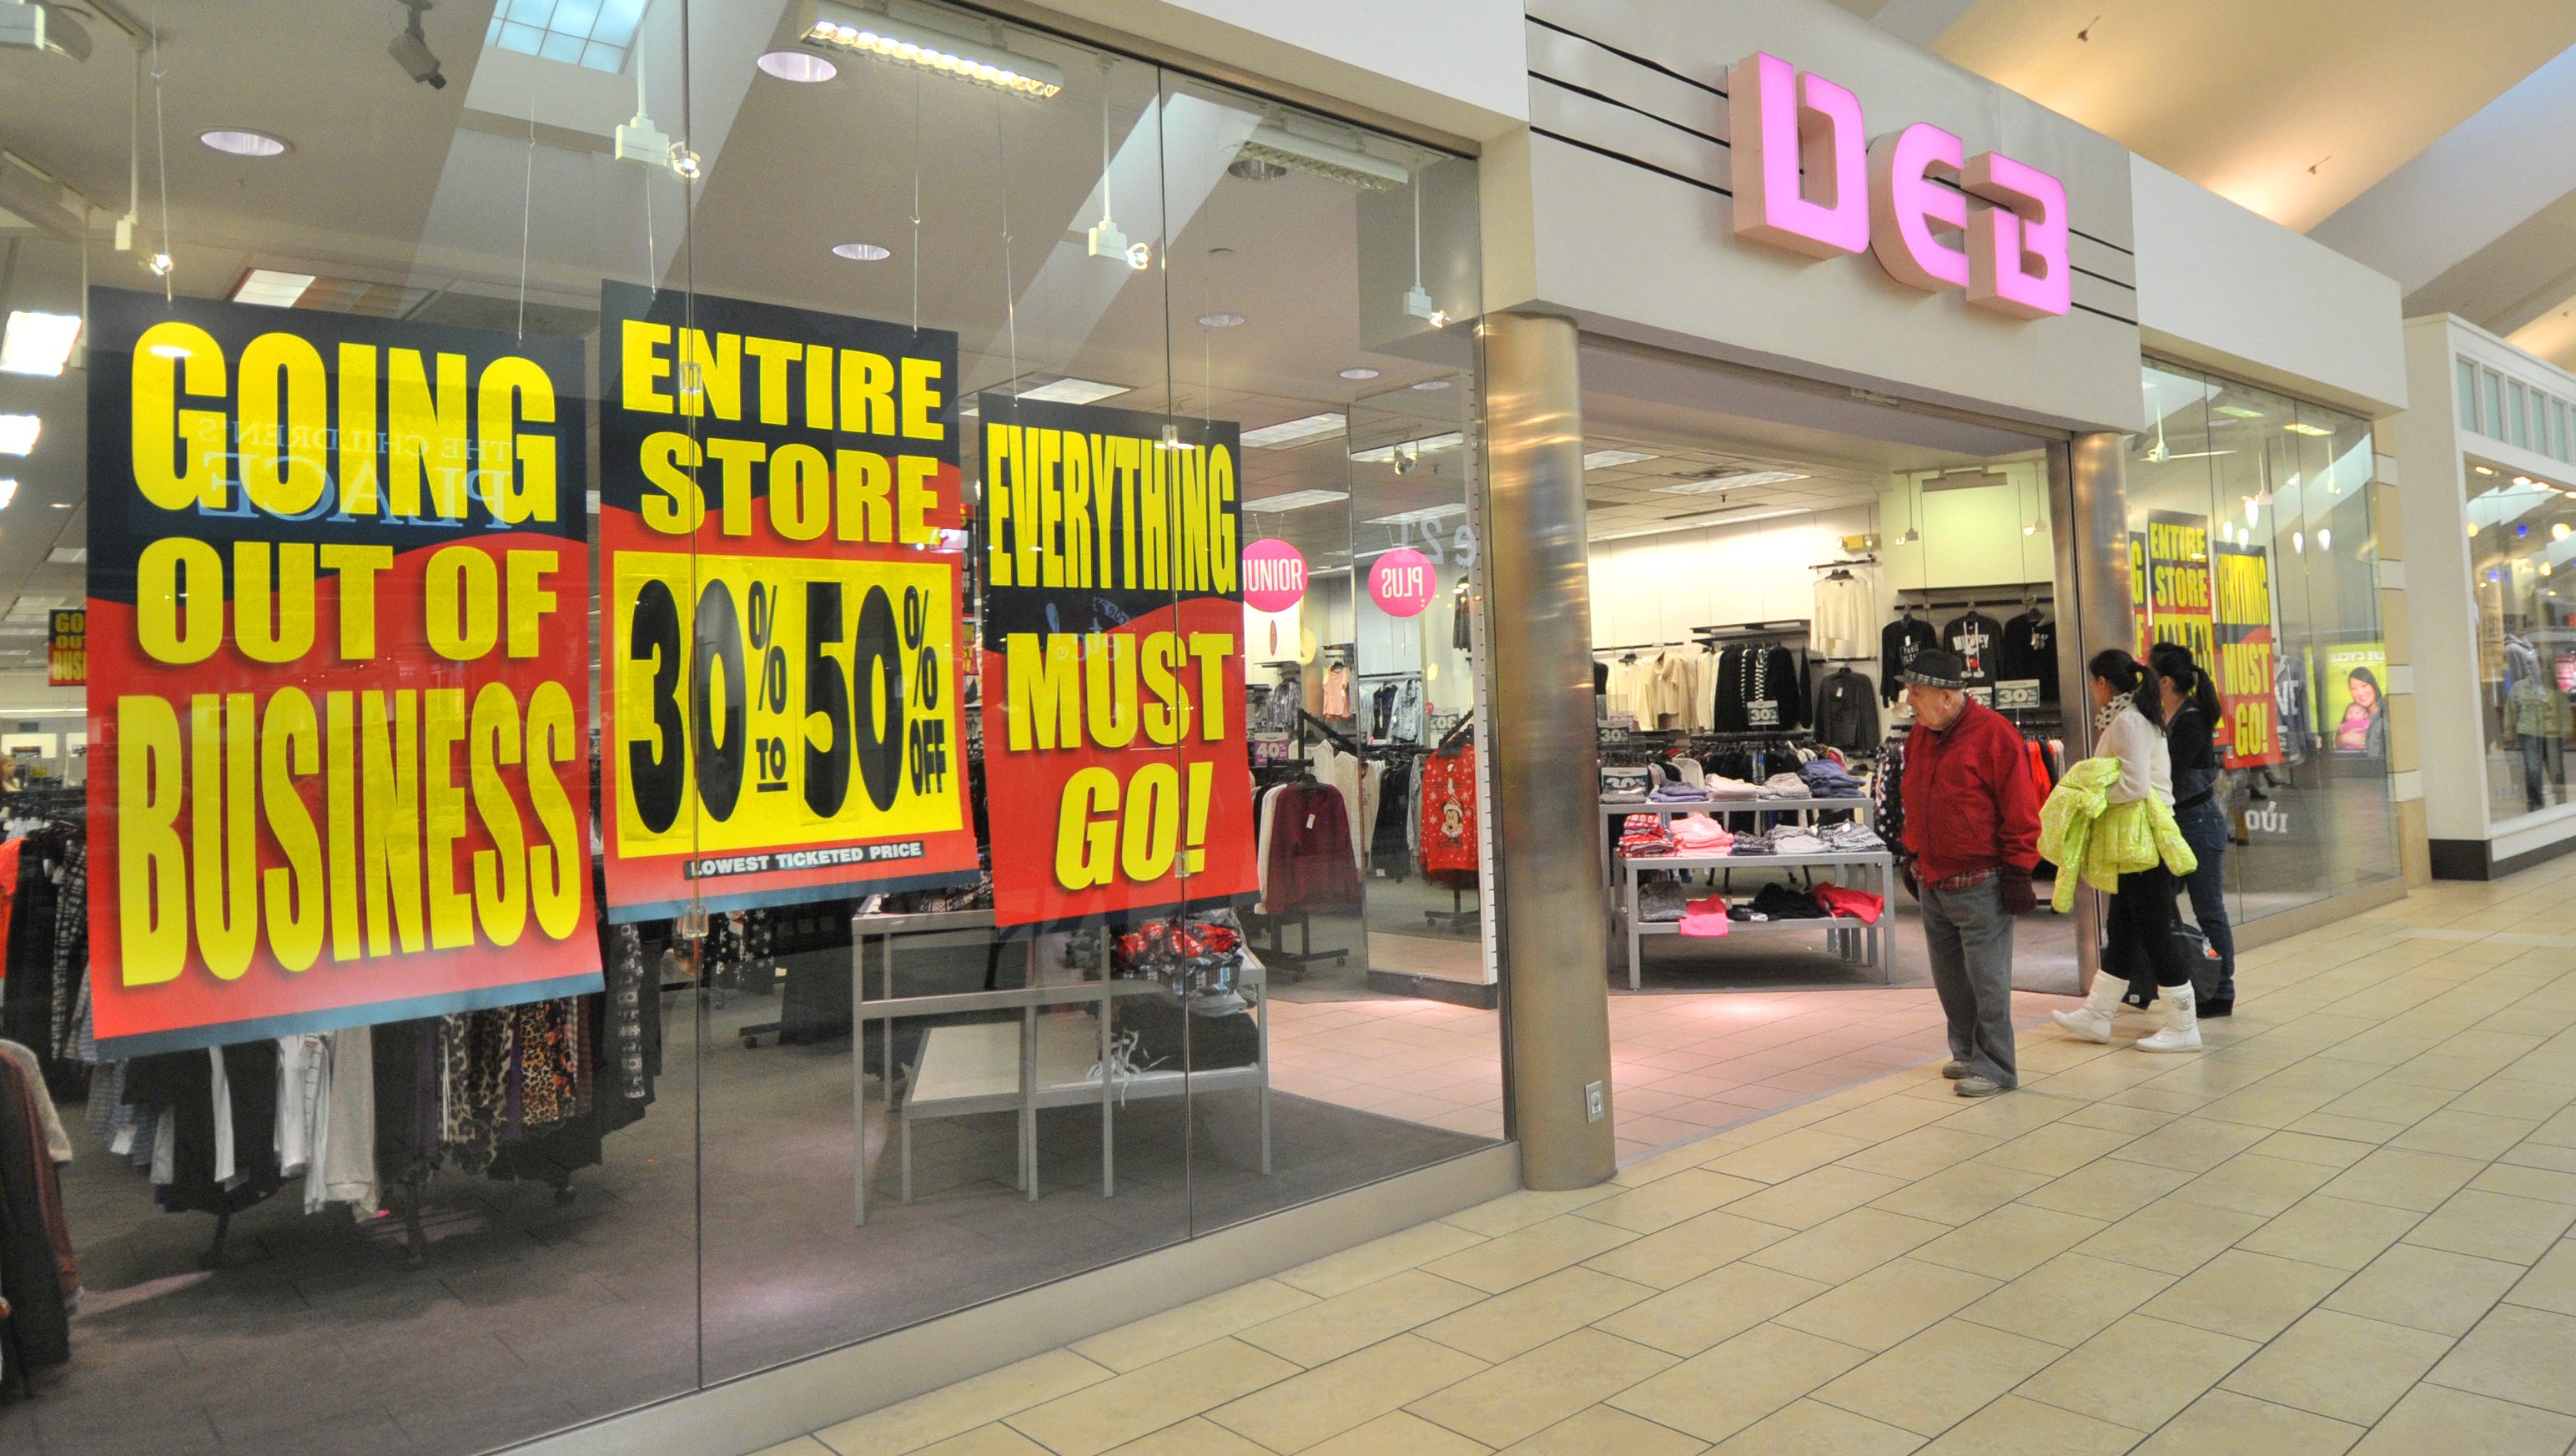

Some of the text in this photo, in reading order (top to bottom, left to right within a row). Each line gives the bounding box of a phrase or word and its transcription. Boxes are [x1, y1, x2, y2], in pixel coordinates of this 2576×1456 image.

[1728, 50, 2070, 317] DEB
[131, 321, 557, 523] GOING
[622, 319, 944, 440] ENTIRE
[640, 431, 939, 546] STORE
[988, 422, 1237, 594] EVERYTHING
[2150, 522, 2206, 562] ENTIRE
[137, 537, 560, 665] OUT OF
[2155, 565, 2209, 607] STORE
[628, 578, 787, 834] 30%
[803, 581, 938, 819] 50%
[909, 718, 948, 797] OFF
[1007, 631, 1235, 752] MUST
[2222, 643, 2271, 695] MUST
[2235, 703, 2269, 757] GO!
[118, 680, 581, 986] BUSINESS
[691, 841, 923, 877] LOWEST TICKETED PRICE
[1054, 761, 1214, 890] GO!
